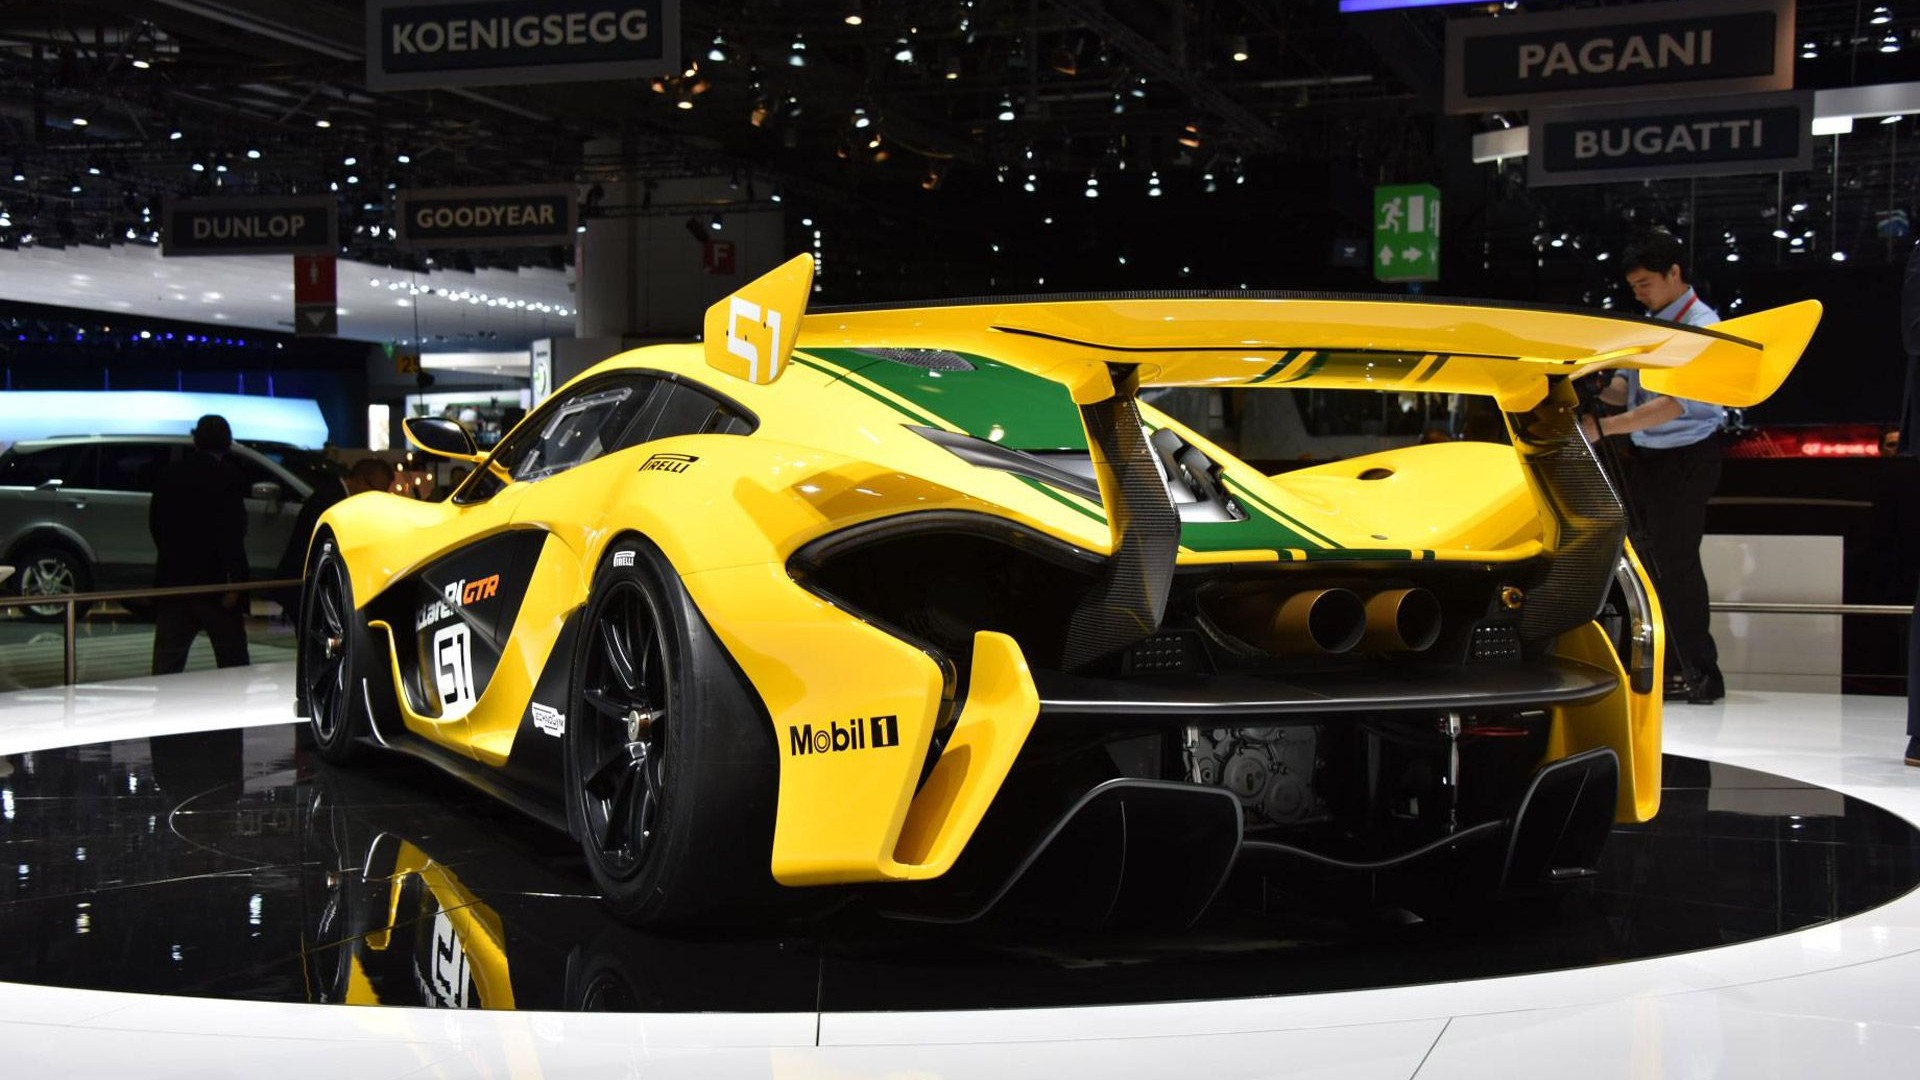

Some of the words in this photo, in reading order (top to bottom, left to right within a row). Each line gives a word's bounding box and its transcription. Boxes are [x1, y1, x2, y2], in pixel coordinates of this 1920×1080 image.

[392, 9, 649, 55] KOENIGSEGG
[1517, 29, 1714, 79] PAGANI
[1573, 118, 1764, 159] BUGATTI
[192, 214, 306, 240] DUNLOP
[416, 203, 556, 230] GOODYEAR
[713, 243, 730, 268] F
[727, 296, 782, 385] 51
[638, 453, 700, 474] PIRELLI
[613, 551, 636, 567] PIRELLI
[463, 574, 500, 605] GTR
[438, 632, 470, 706] 51
[789, 717, 865, 757] Mobil
